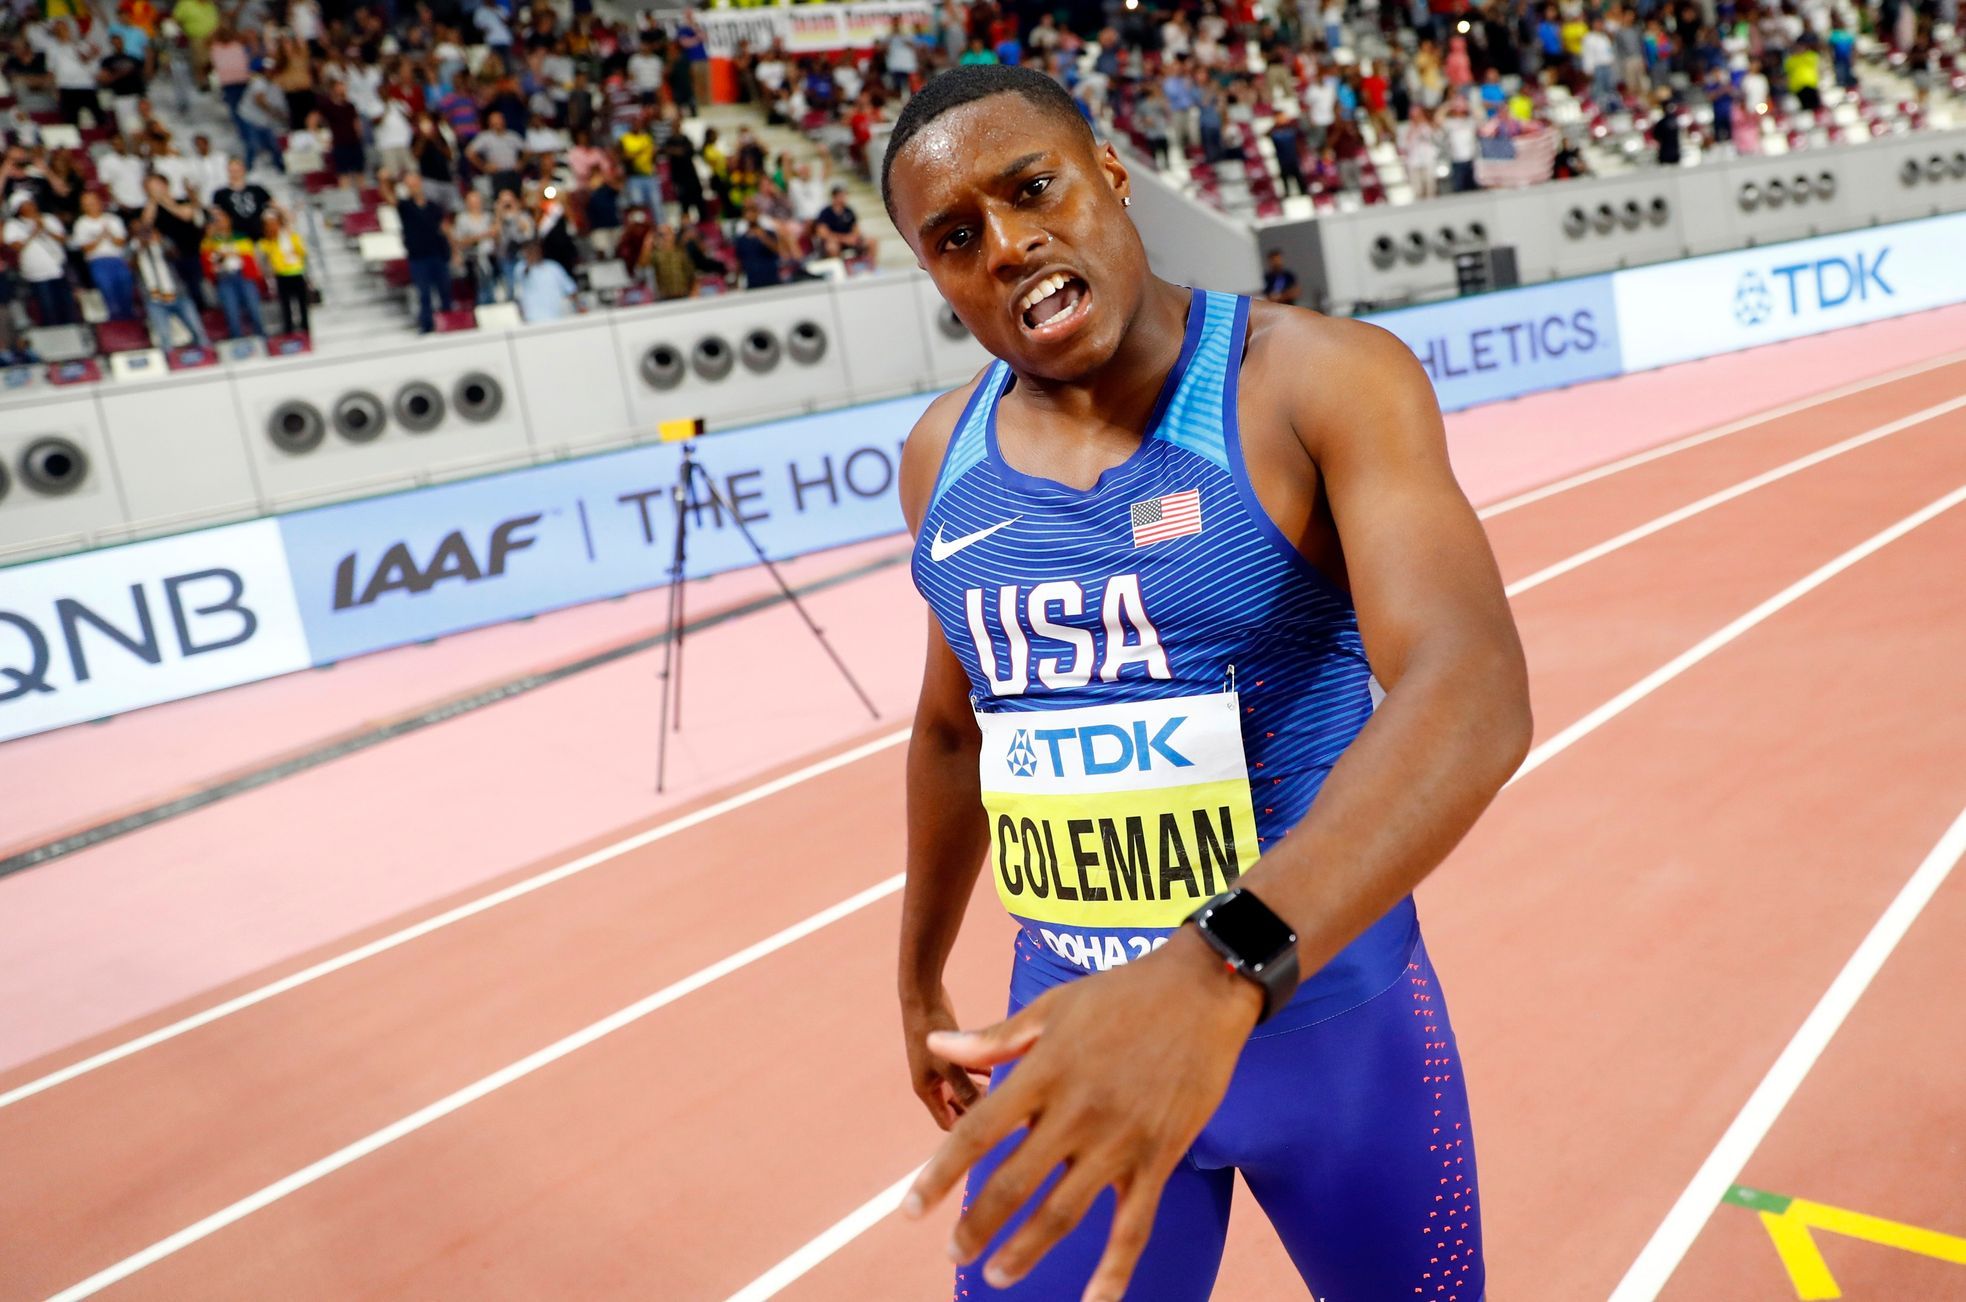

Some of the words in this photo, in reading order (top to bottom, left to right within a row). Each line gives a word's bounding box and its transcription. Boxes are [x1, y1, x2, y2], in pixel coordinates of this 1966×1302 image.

[1772, 246, 1894, 315] TDK
[333, 512, 543, 611] IAAF
[618, 470, 770, 544] THE
[787, 441, 905, 512] HO
[0, 567, 258, 700] QNB
[964, 573, 1174, 697] USA
[1034, 716, 1196, 778] TDK
[998, 806, 1240, 902] COLEMAN
